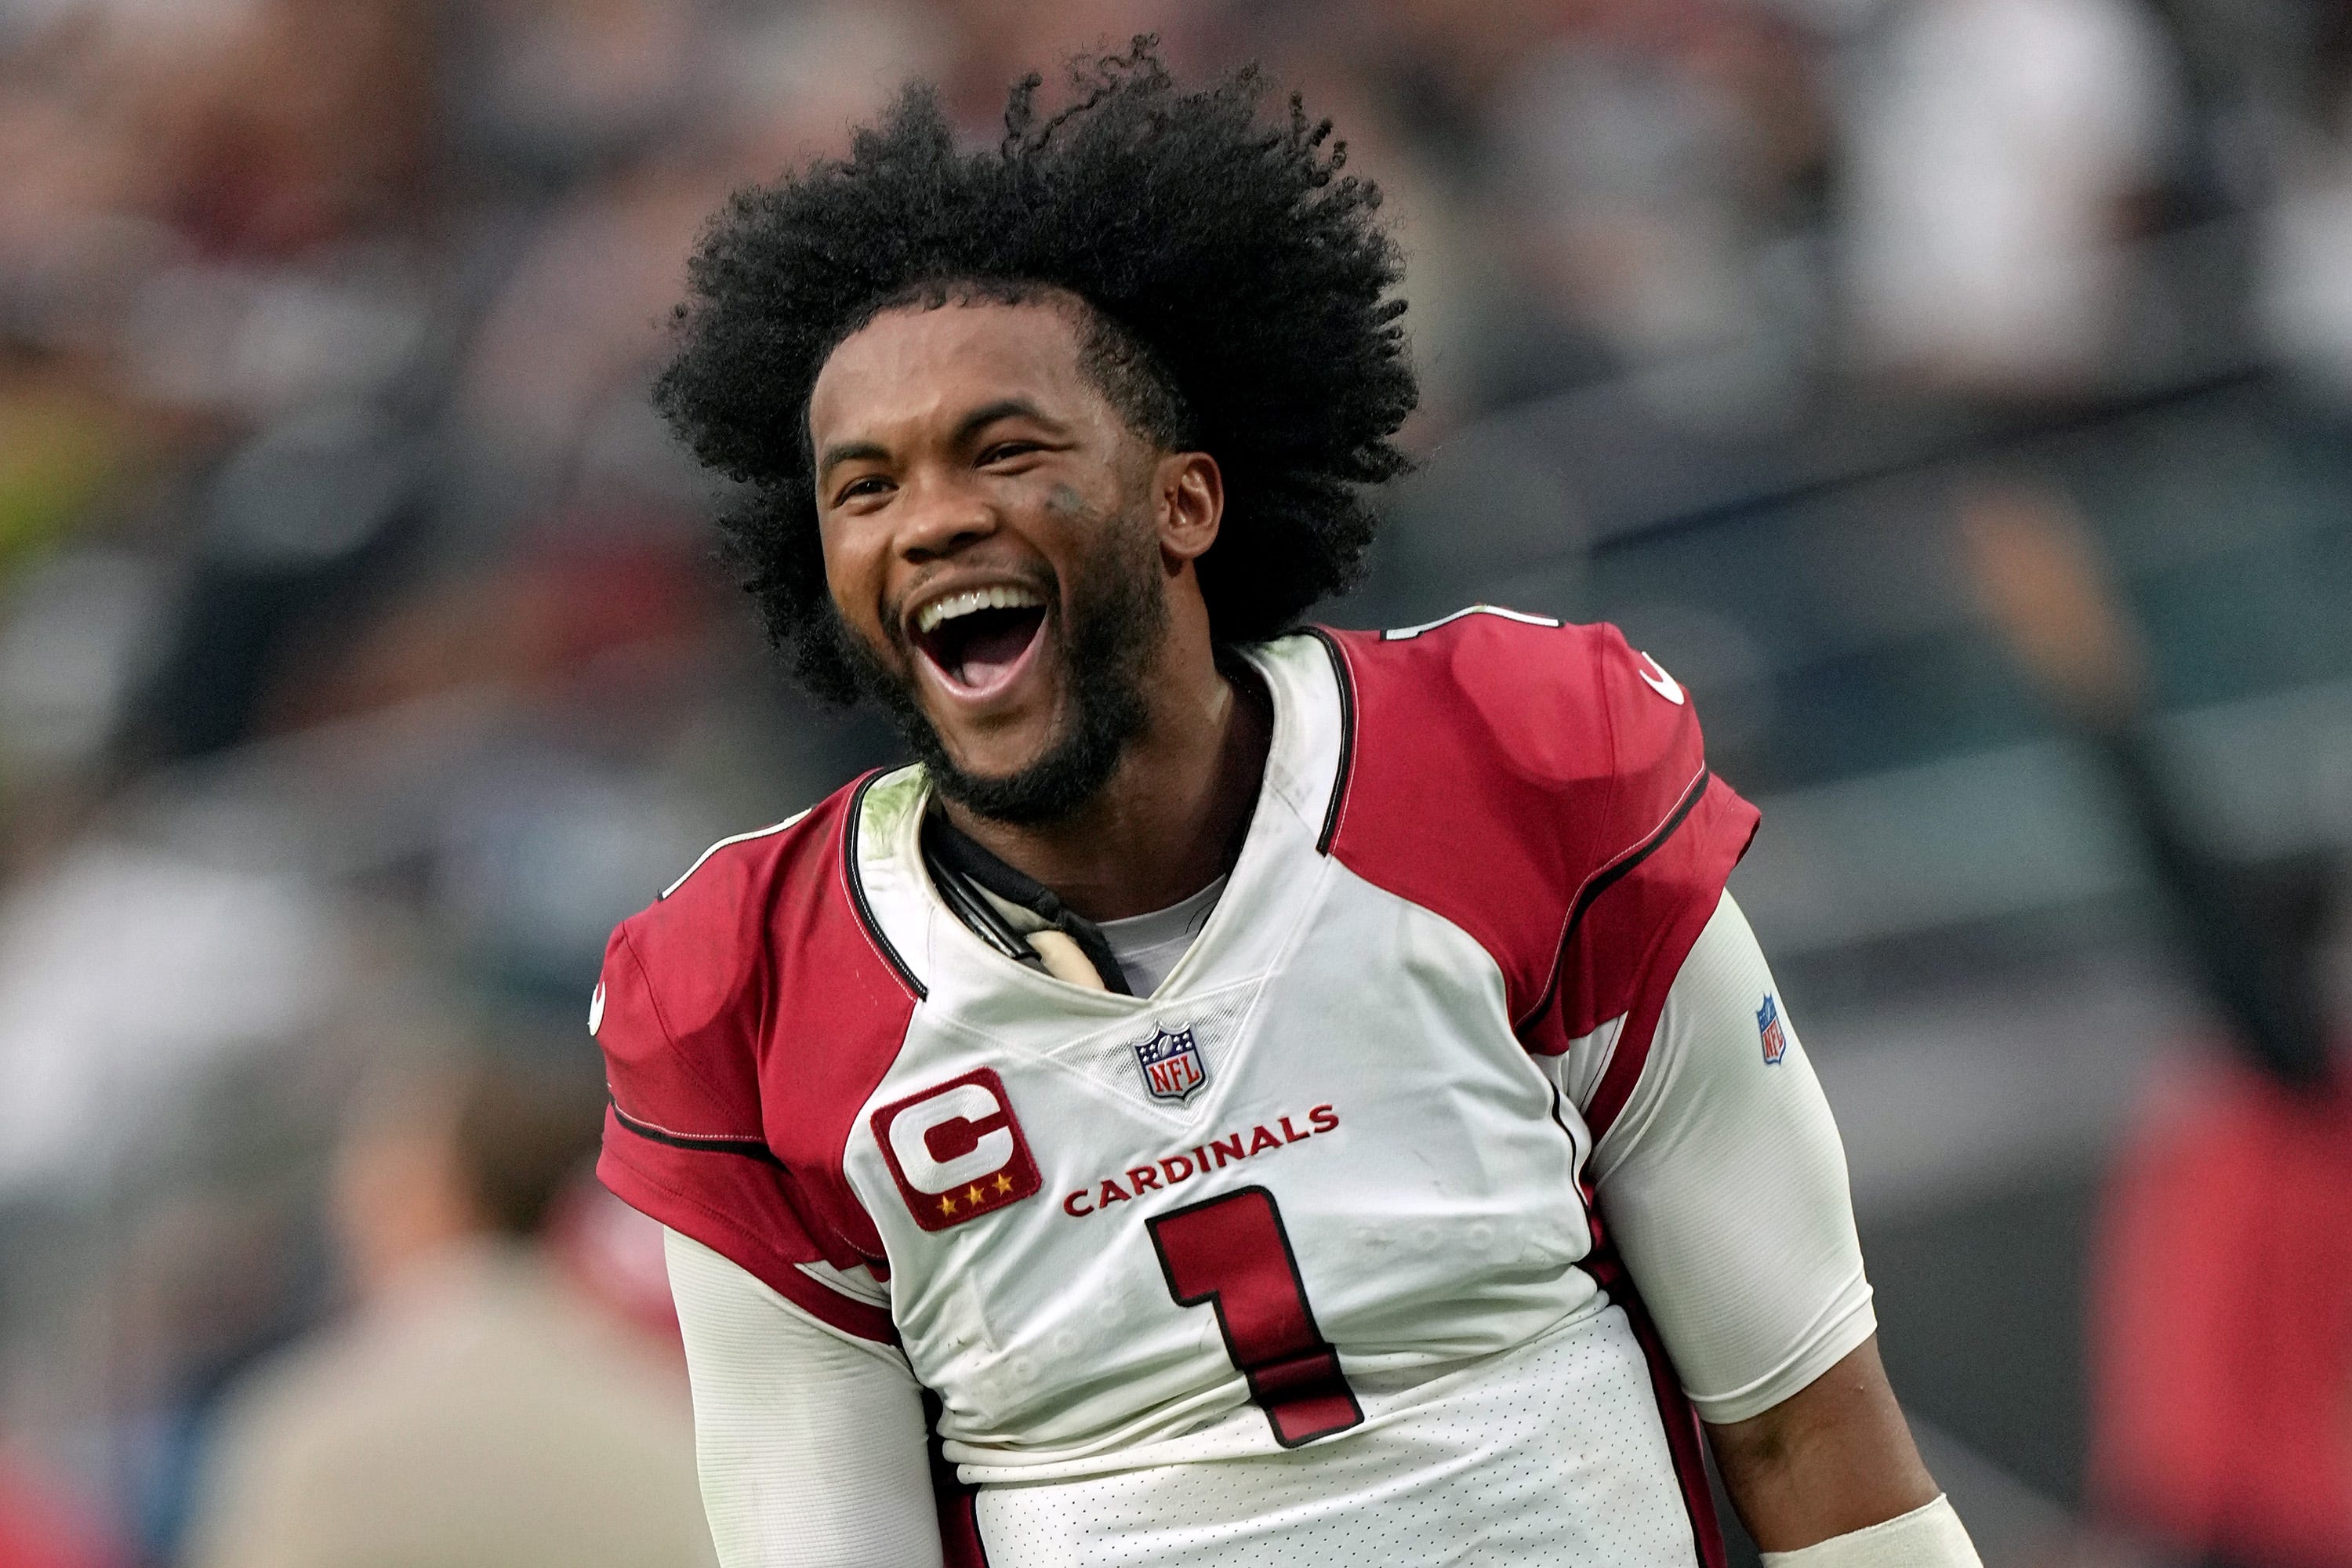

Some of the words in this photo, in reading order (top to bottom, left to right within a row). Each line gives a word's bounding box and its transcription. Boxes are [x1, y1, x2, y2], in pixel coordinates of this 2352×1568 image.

[1148, 1054, 1200, 1093] NFL
[1762, 1018, 1784, 1058] NFL
[889, 1083, 1014, 1196] C
[1063, 1104, 1340, 1217] CARDINALS
[1145, 1185, 1365, 1449] 1
